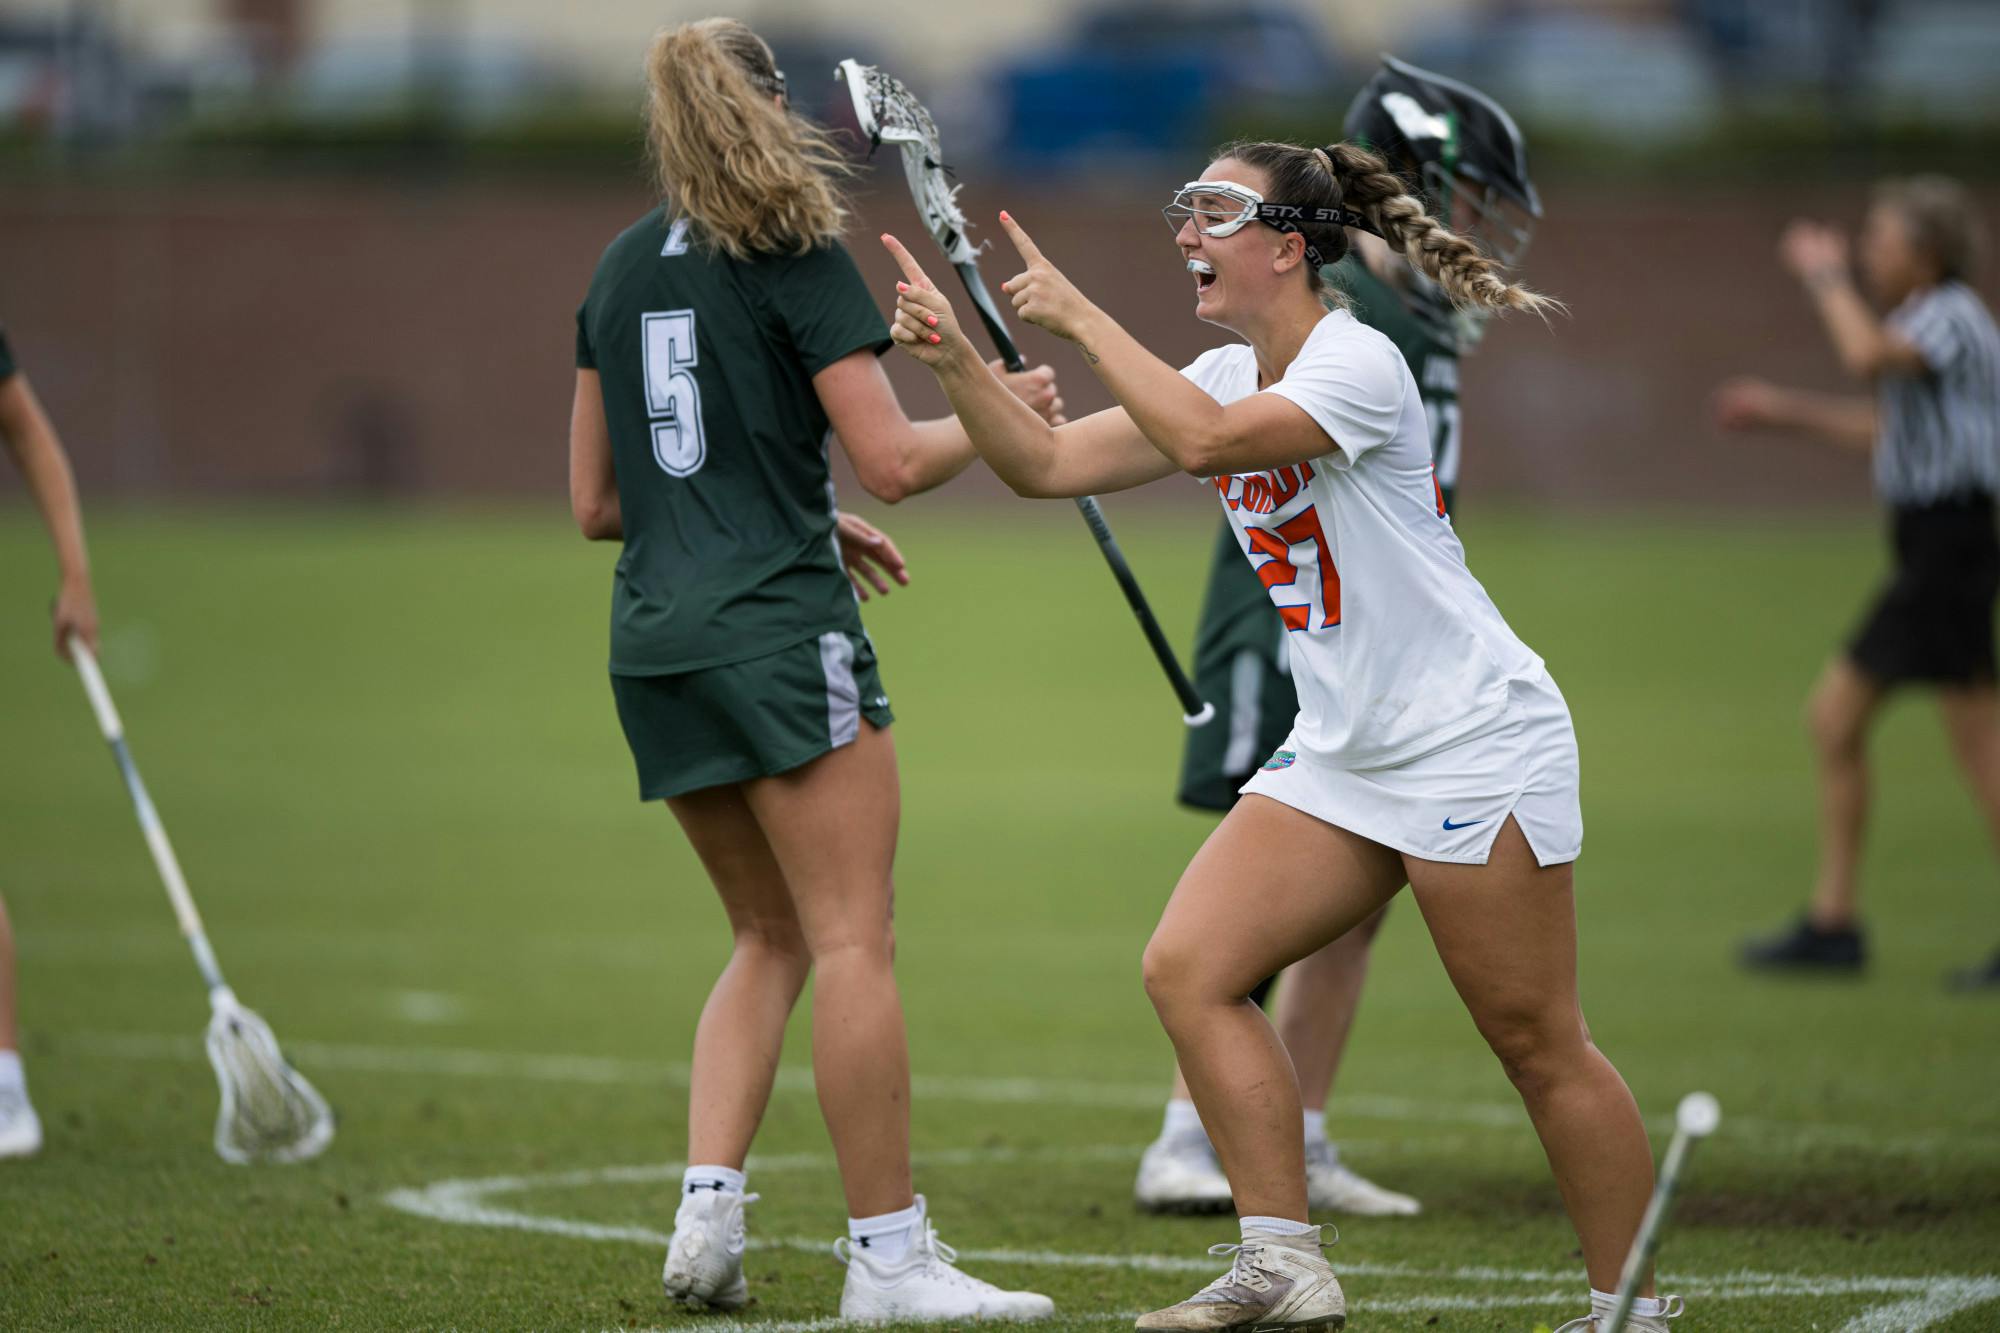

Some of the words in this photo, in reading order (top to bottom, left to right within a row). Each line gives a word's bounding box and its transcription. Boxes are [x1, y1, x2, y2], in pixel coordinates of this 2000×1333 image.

[1261, 204, 1303, 219] STX
[641, 308, 707, 478] 5
[1244, 503, 1341, 632] 27
